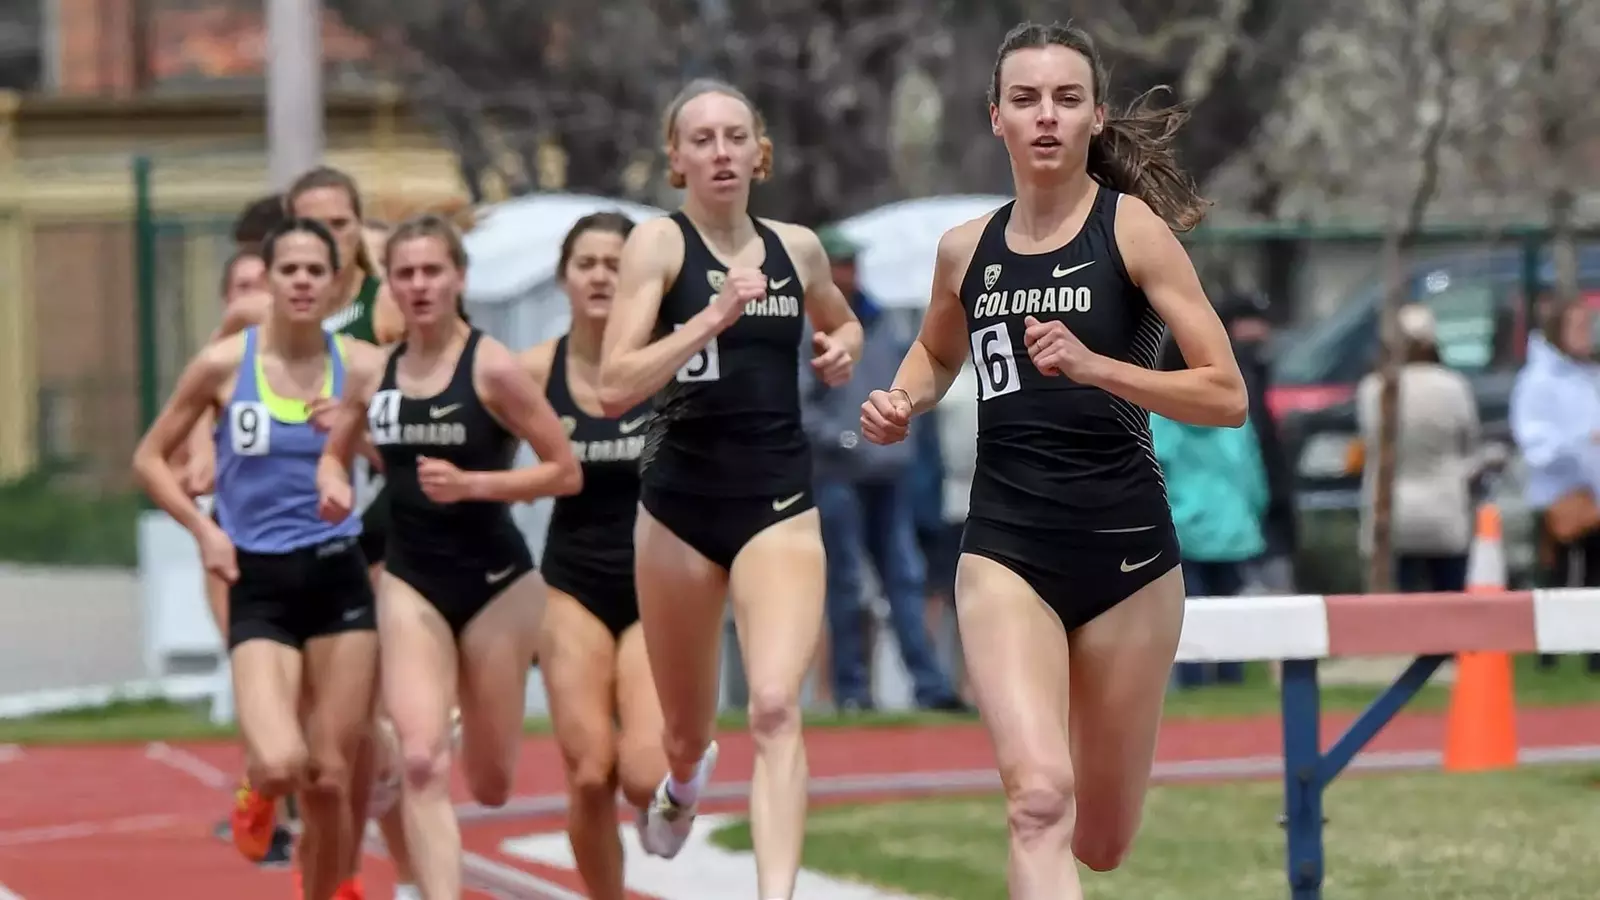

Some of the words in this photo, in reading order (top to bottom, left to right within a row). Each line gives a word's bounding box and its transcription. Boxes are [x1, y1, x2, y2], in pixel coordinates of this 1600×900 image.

[974, 286, 1092, 319] COLORADO
[981, 330, 1009, 393] 6
[239, 408, 257, 449] 9
[375, 396, 391, 437] 4
